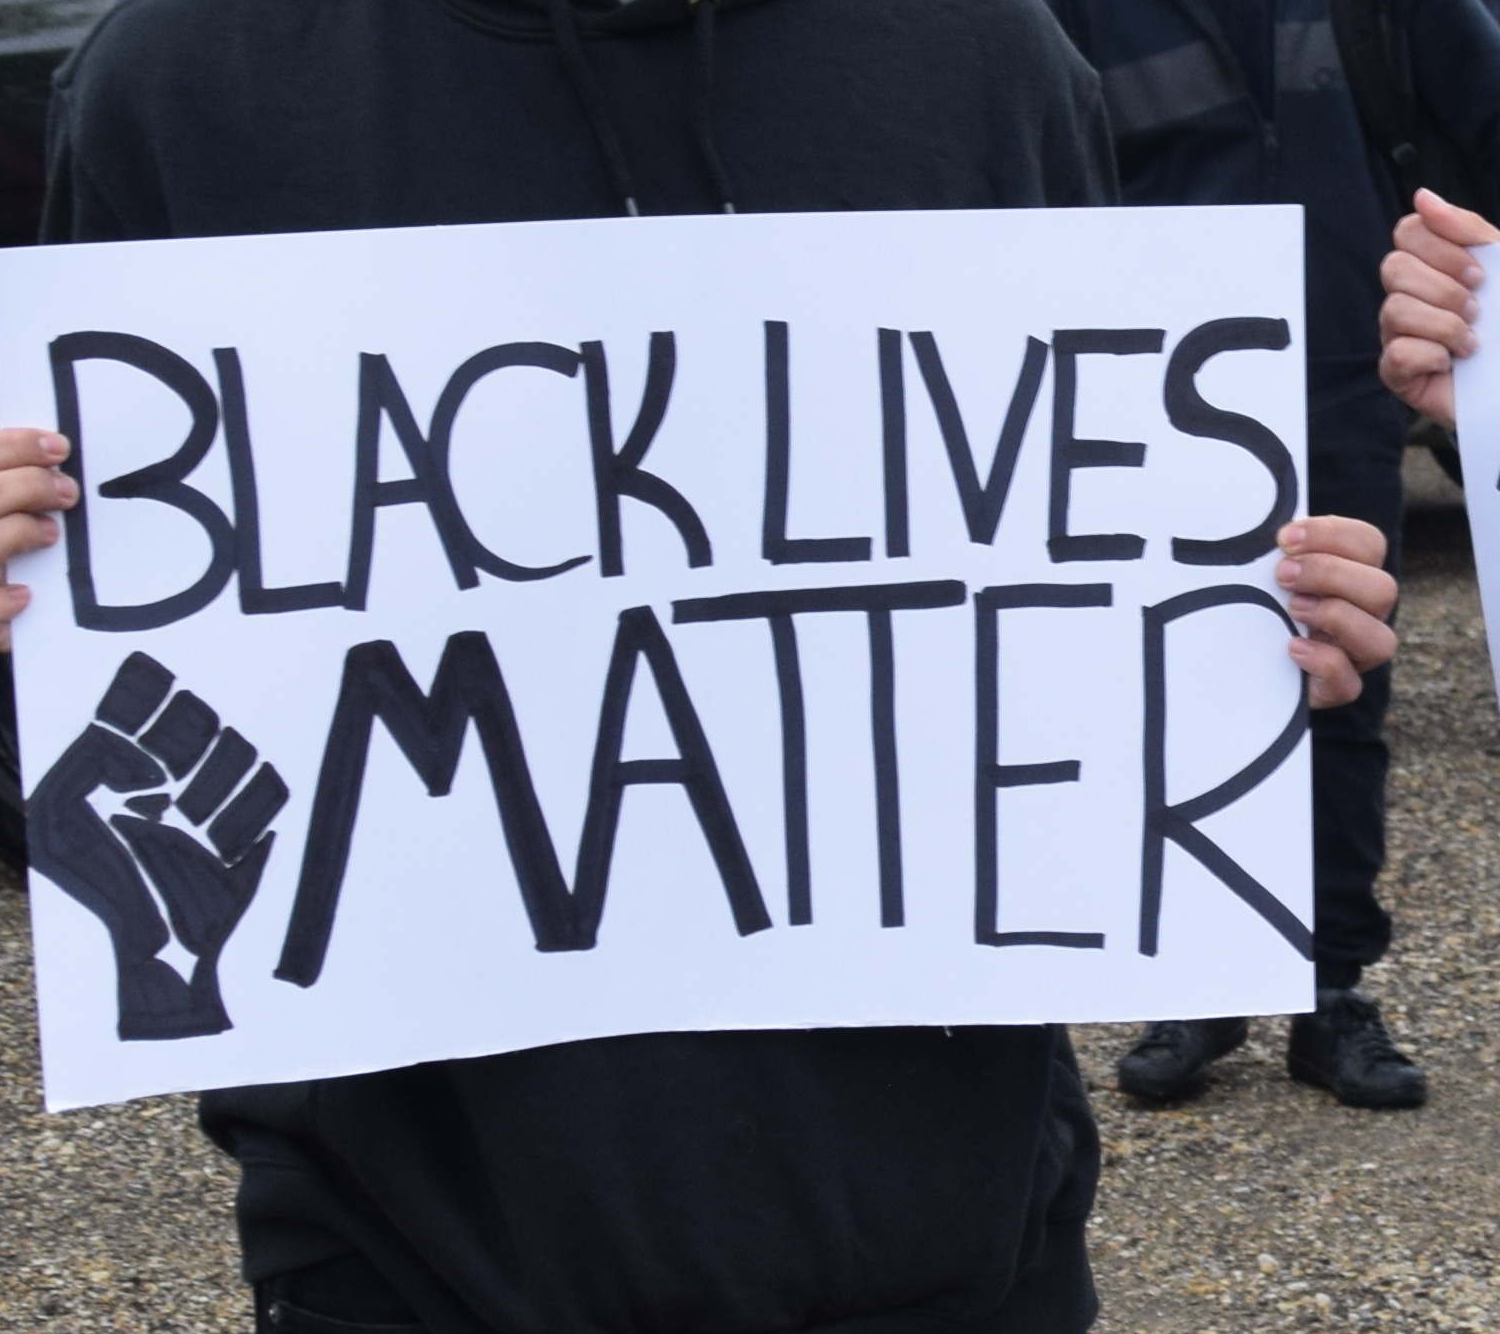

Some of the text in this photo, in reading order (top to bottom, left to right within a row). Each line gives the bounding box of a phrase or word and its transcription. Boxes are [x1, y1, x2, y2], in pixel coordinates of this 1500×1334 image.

[49, 316, 1299, 633] BLACK LIVES
[272, 578, 1315, 989] MATTER
